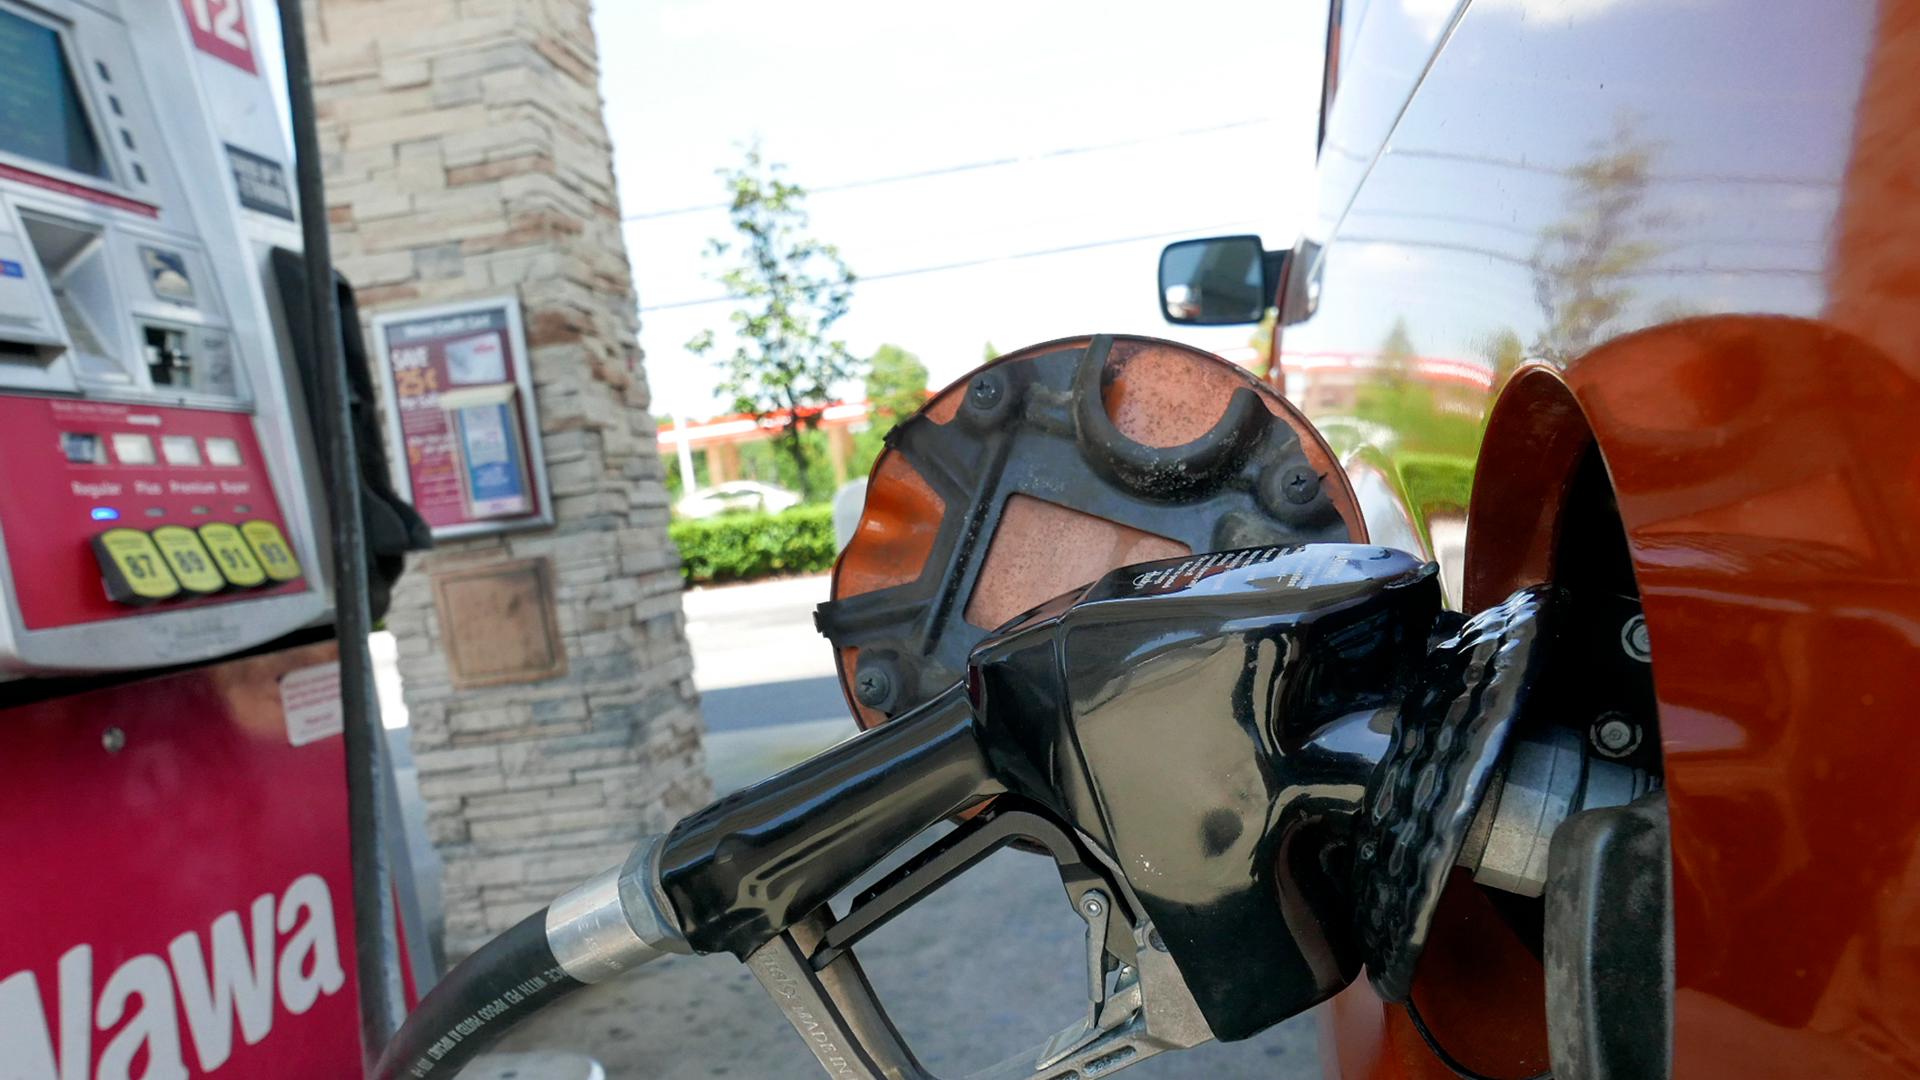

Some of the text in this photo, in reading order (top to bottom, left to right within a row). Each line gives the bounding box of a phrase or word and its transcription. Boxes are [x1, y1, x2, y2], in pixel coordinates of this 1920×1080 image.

[190, 0, 248, 51] 12
[71, 479, 249, 498] Regular Plus Premium Super
[126, 554, 156, 579] 87
[174, 551, 205, 574] 89
[220, 548, 249, 569] 91
[519, 977, 547, 996] WITH
[793, 1005, 837, 1053] MADE
[829, 1056, 853, 1075] IN
